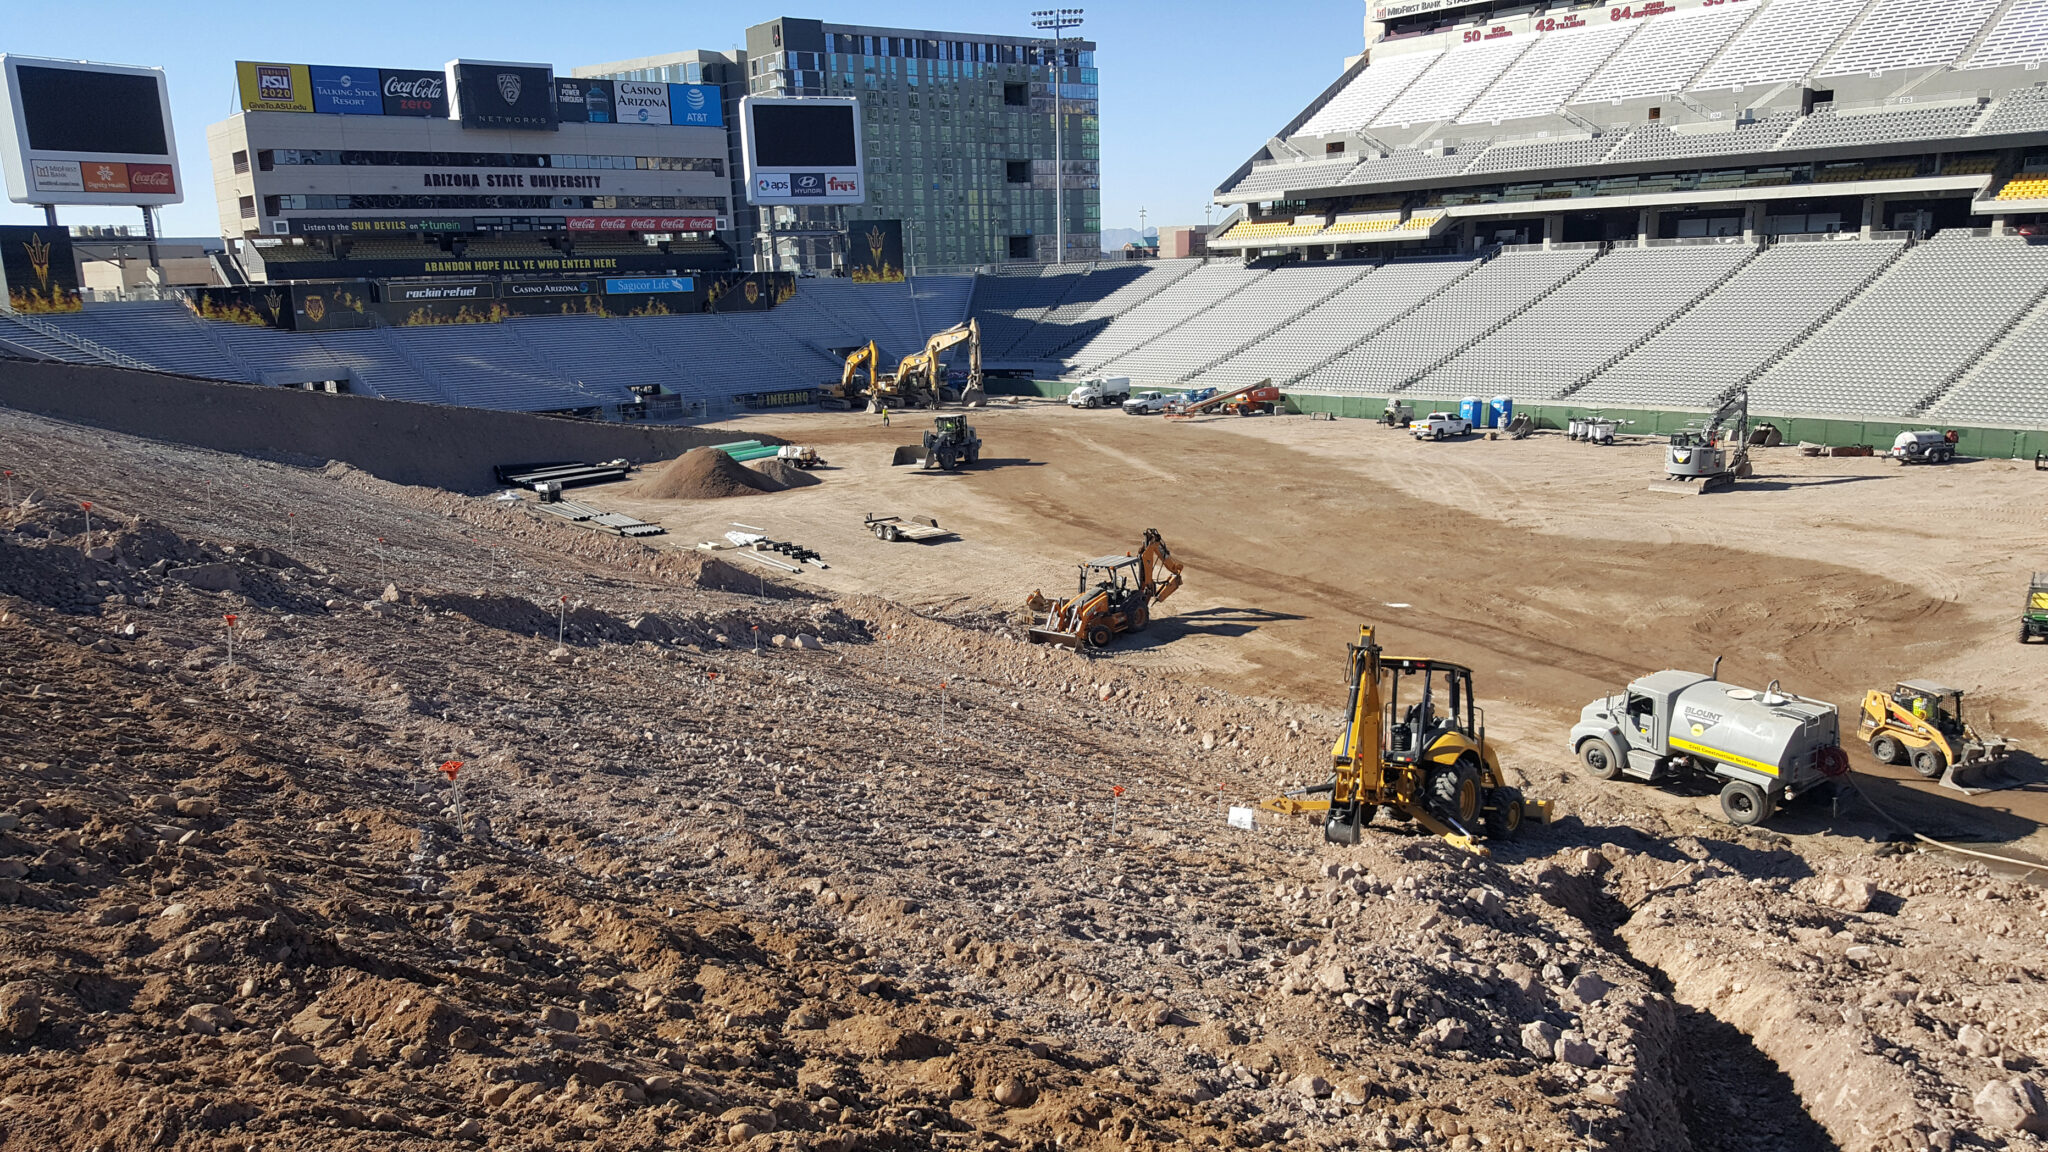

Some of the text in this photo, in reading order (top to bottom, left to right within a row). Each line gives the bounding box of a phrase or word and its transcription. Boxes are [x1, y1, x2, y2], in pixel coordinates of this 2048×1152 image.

[1421, 0, 1441, 11] BANK
[1643, 1, 1665, 11] JOHN
[1610, 6, 1631, 21] 84
[1632, 6, 1676, 19] JEFFERSON
[1535, 18, 1555, 32] 42
[1555, 20, 1586, 30] TILLMAN
[1463, 29, 1481, 43] 50
[261, 75, 289, 89] ASU
[262, 89, 291, 98] 2020
[316, 86, 378, 97] TALKING STICK
[505, 89, 516, 99] 12
[561, 88, 580, 96] POWER
[620, 83, 662, 96] CASINO
[333, 96, 366, 106] RESORT
[559, 95, 584, 103] THROUGH
[617, 95, 667, 108] ARIZONA
[401, 100, 432, 110] zero
[479, 115, 546, 124] NETWORKS
[687, 112, 707, 122] AT&T
[424, 173, 601, 189] ARIZONA STATE UNIVERSITY
[771, 181, 789, 191] aps
[303, 223, 327, 231] Listen
[337, 223, 349, 231] the
[351, 221, 371, 231] SUN
[374, 220, 407, 230] DEVILS
[424, 258, 617, 272] ABANDON HOPE ALL YE WHO ENTER HERE
[512, 284, 579, 294] CASINO ARIZONA
[618, 279, 670, 291] Sagicor Life
[766, 391, 808, 405] INFERNO
[1684, 706, 1723, 721] BLOUNT
[1689, 743, 1701, 751] Civil
[1701, 747, 1735, 761] Construction
